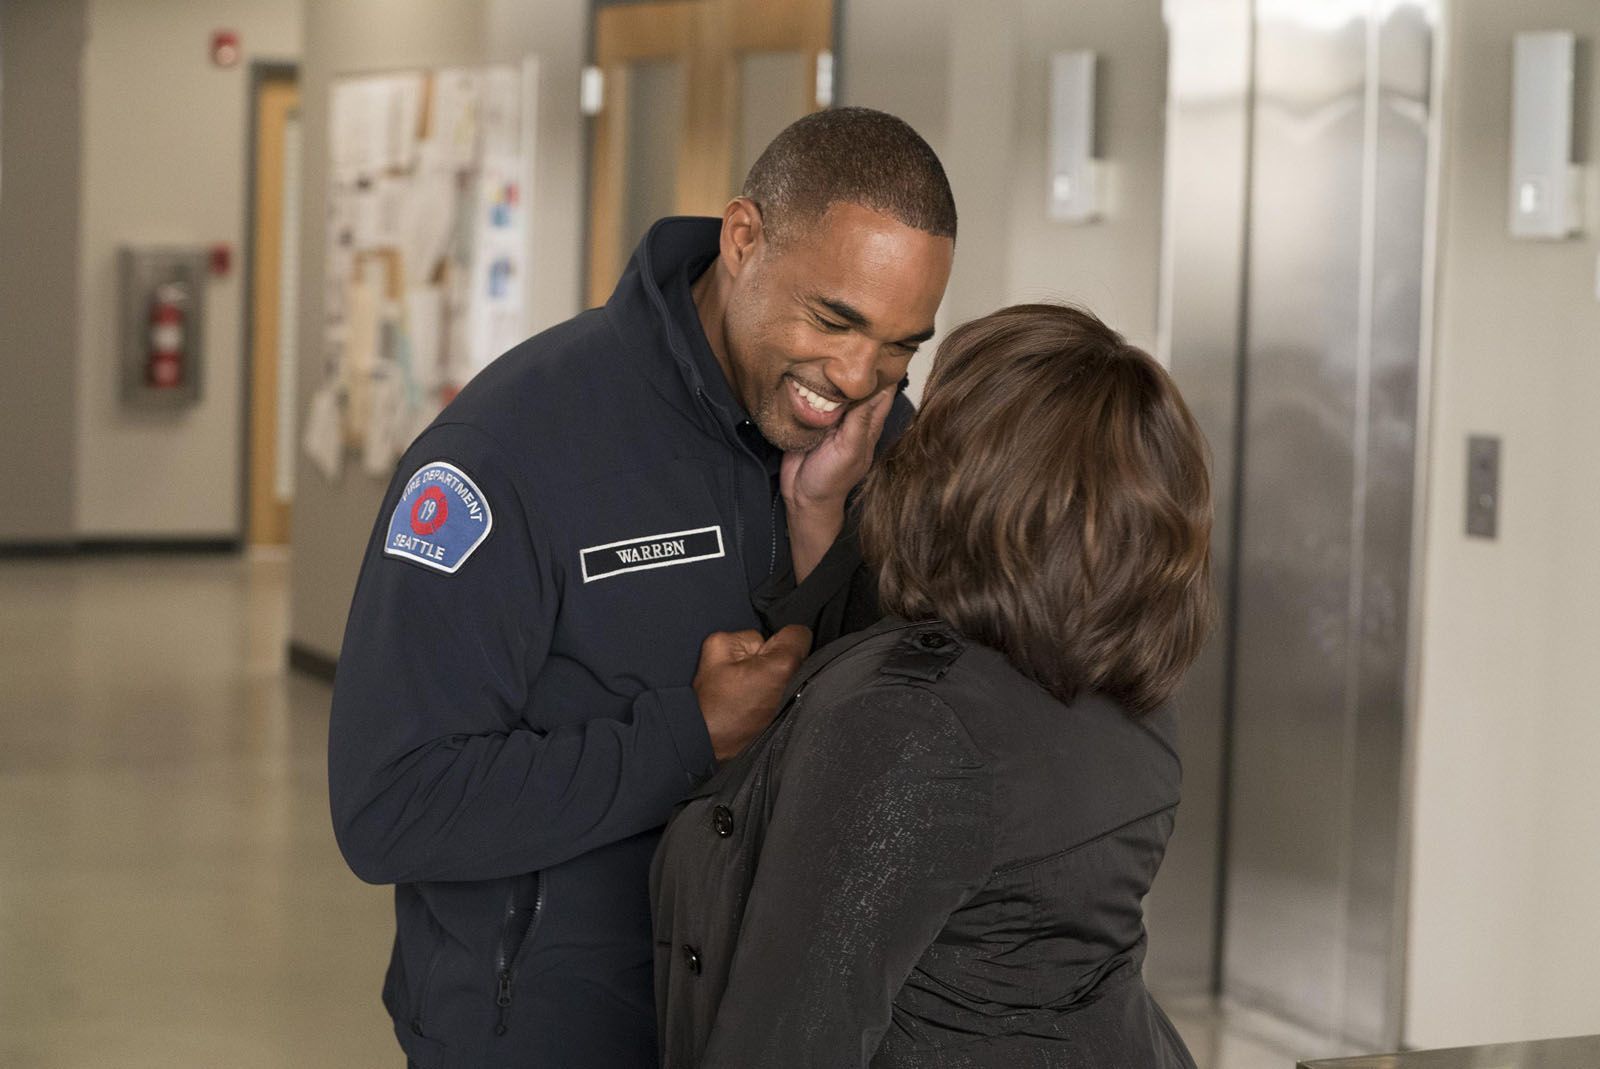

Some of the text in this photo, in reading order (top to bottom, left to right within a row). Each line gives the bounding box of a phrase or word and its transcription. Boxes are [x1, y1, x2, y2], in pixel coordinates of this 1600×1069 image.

[422, 469, 483, 522] DEPARTMENT
[420, 499, 437, 521] 19
[393, 533, 446, 561] SEATTLE
[616, 539, 685, 564] WARREN
